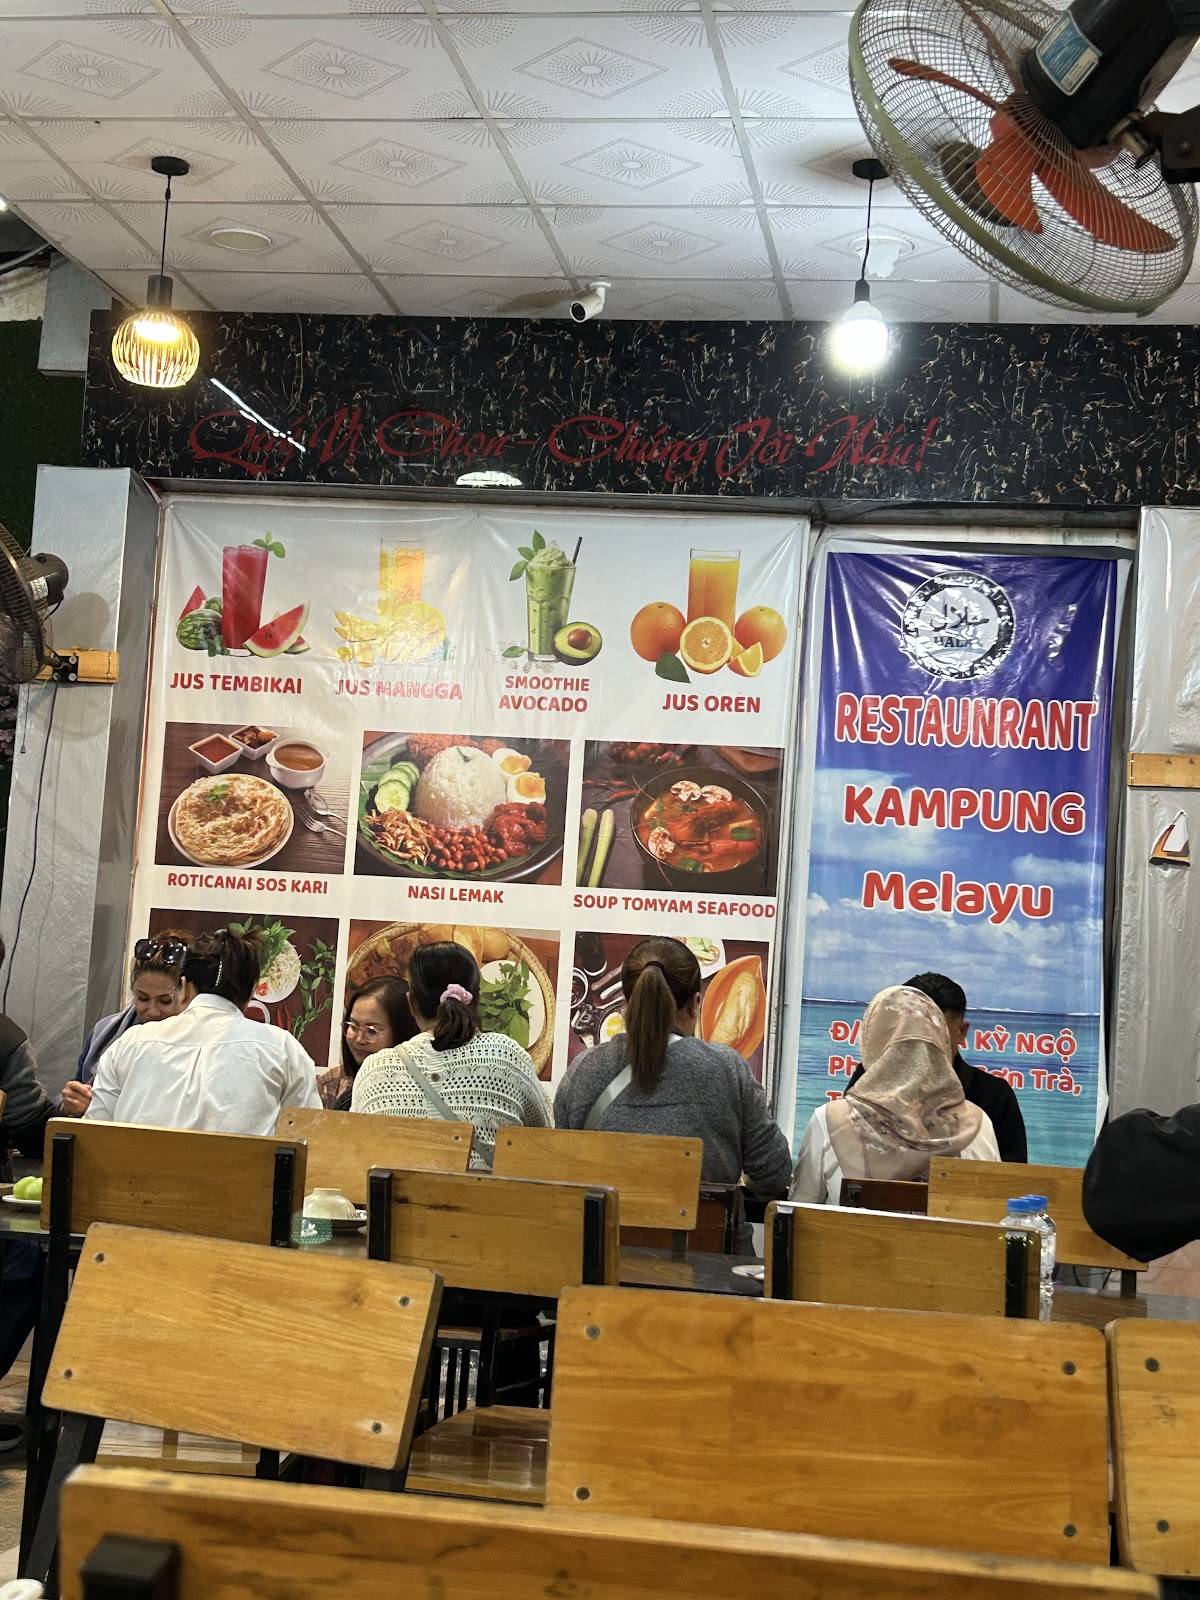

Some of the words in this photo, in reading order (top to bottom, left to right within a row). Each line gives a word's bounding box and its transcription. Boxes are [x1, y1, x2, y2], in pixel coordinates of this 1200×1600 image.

[546, 415, 709, 483] Chúng
[715, 416, 794, 478] Tôi
[803, 414, 939, 475] Nấu!
[170, 672, 205, 690] JUS
[209, 673, 302, 694] TEMBIKAI
[335, 678, 371, 696] JUS
[375, 680, 463, 700] MANGGA
[504, 675, 590, 692] SMOOTHIE
[498, 694, 588, 713] AVOCADO
[662, 692, 699, 712] JUS
[704, 693, 761, 713] OREN
[834, 693, 1099, 751] RESTAUNRANT
[843, 784, 1087, 835] KAMPUNG
[167, 872, 252, 891] ROTICANAI
[256, 876, 288, 892] SOS
[290, 879, 329, 895] KARI
[407, 884, 446, 901] NASI
[449, 886, 505, 904] LEMAK
[573, 894, 619, 911] SOUP
[621, 896, 694, 915] TOMYAM
[696, 899, 776, 919] SEAFOOD
[862, 870, 1054, 925] Melayu
[829, 1020, 861, 1046] Đ/
[974, 1025, 1009, 1052] KỲ
[1016, 1028, 1077, 1063] NGỘ
[1029, 1066, 1082, 1096] Trà,
